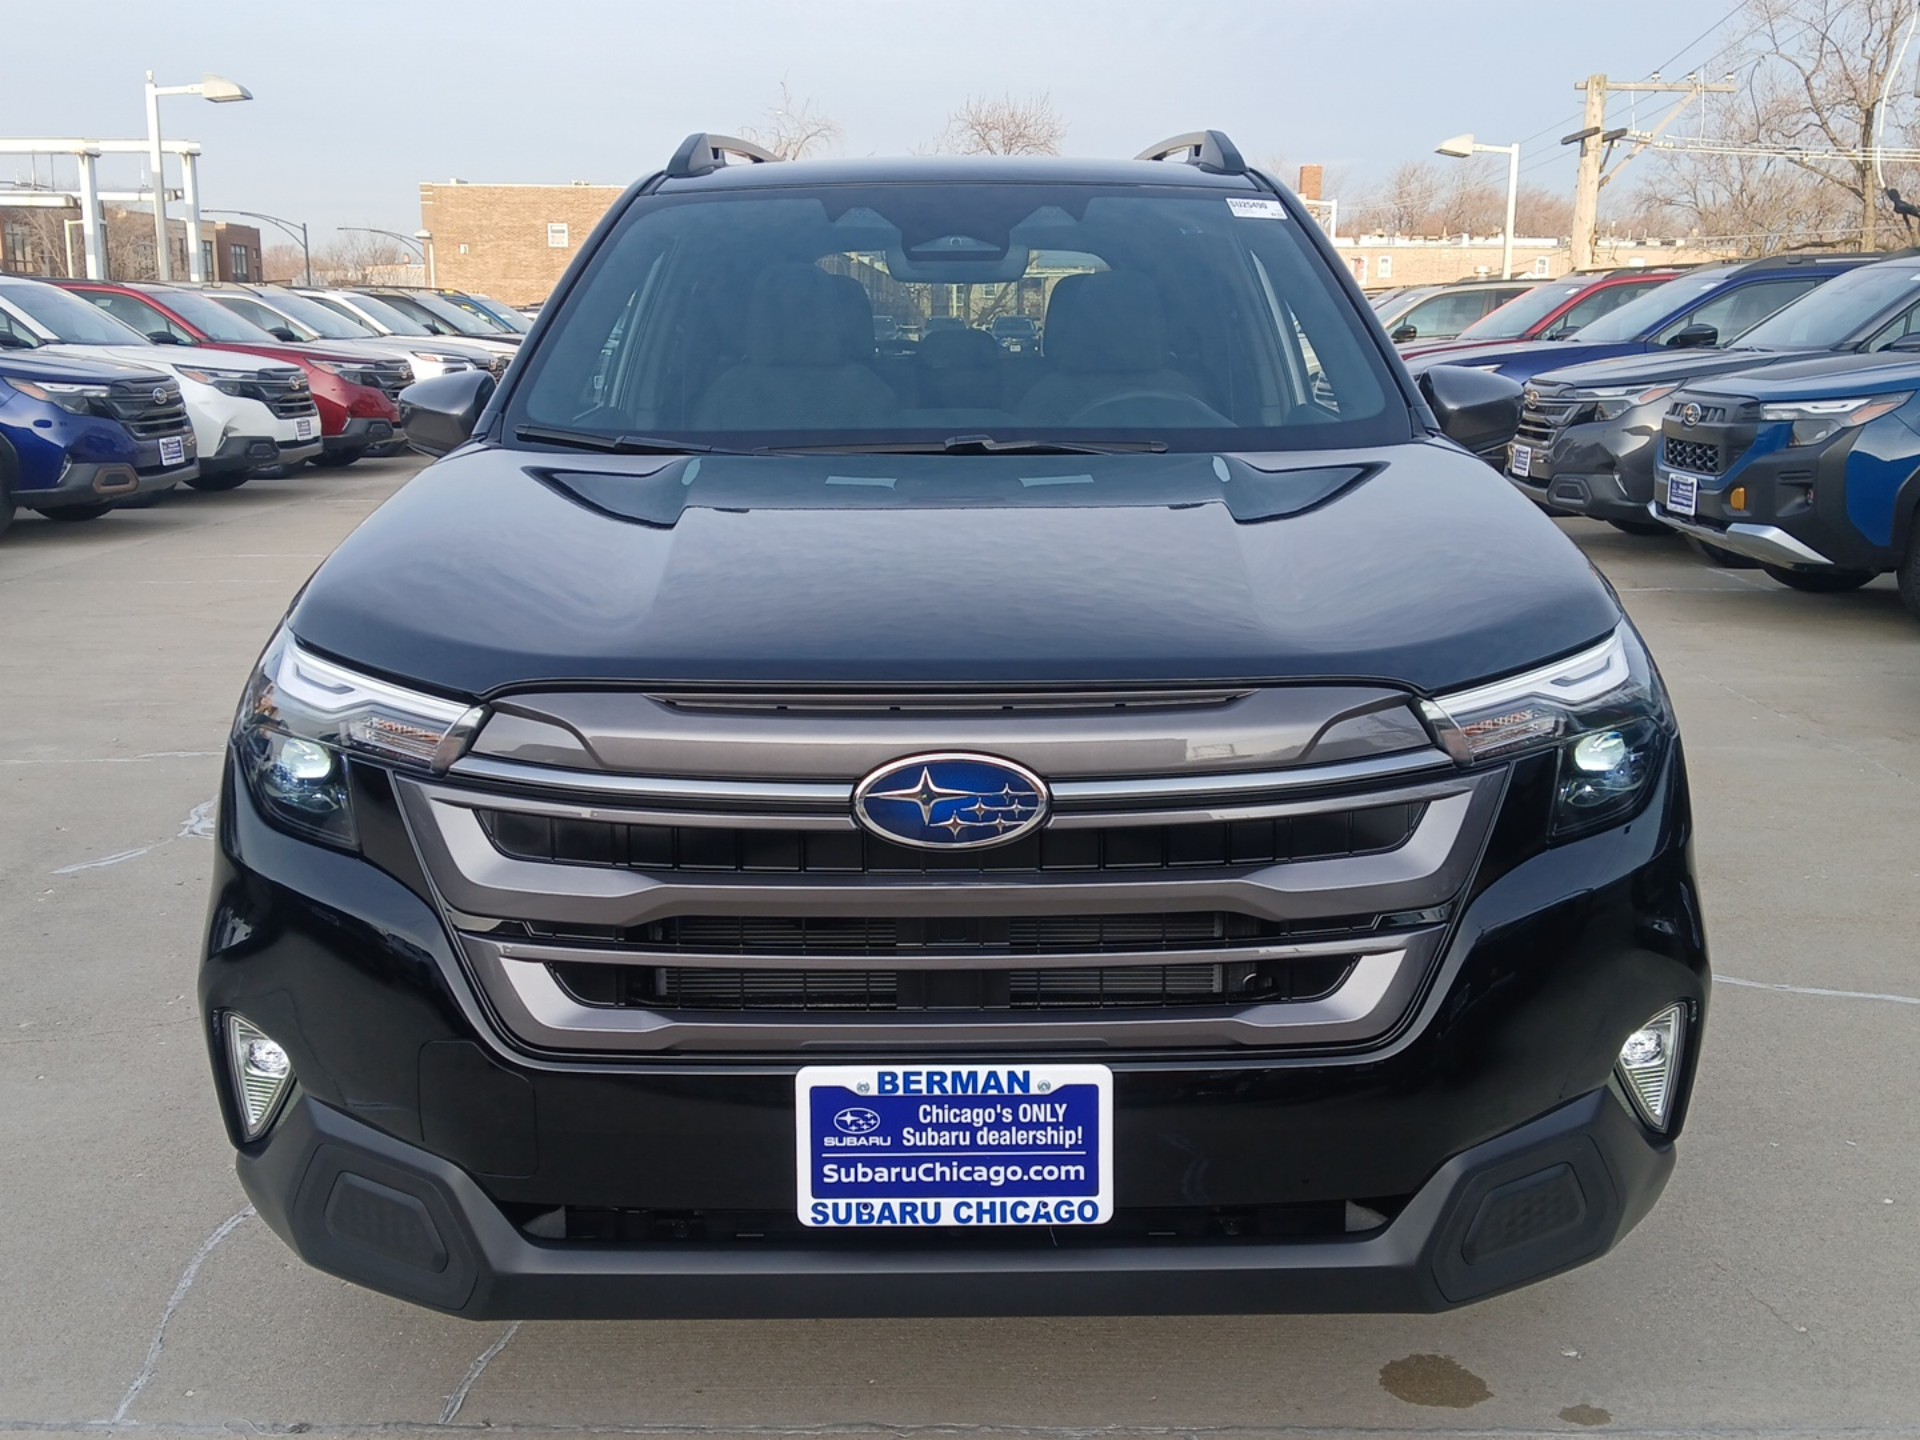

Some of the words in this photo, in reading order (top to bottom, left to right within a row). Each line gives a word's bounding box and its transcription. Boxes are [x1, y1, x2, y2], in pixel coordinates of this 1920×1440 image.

[877, 1070, 1031, 1094] BERMAN
[918, 1104, 1013, 1126] Chicago's
[1018, 1104, 1068, 1123] ONLY
[823, 1136, 892, 1147] SUBARU
[902, 1127, 971, 1146] Subaru
[976, 1126, 1083, 1149] dealership!
[822, 1162, 1086, 1186] SubaruChicago.com
[810, 1202, 941, 1225] SUBARU
[952, 1200, 1099, 1224] CHICAGO
